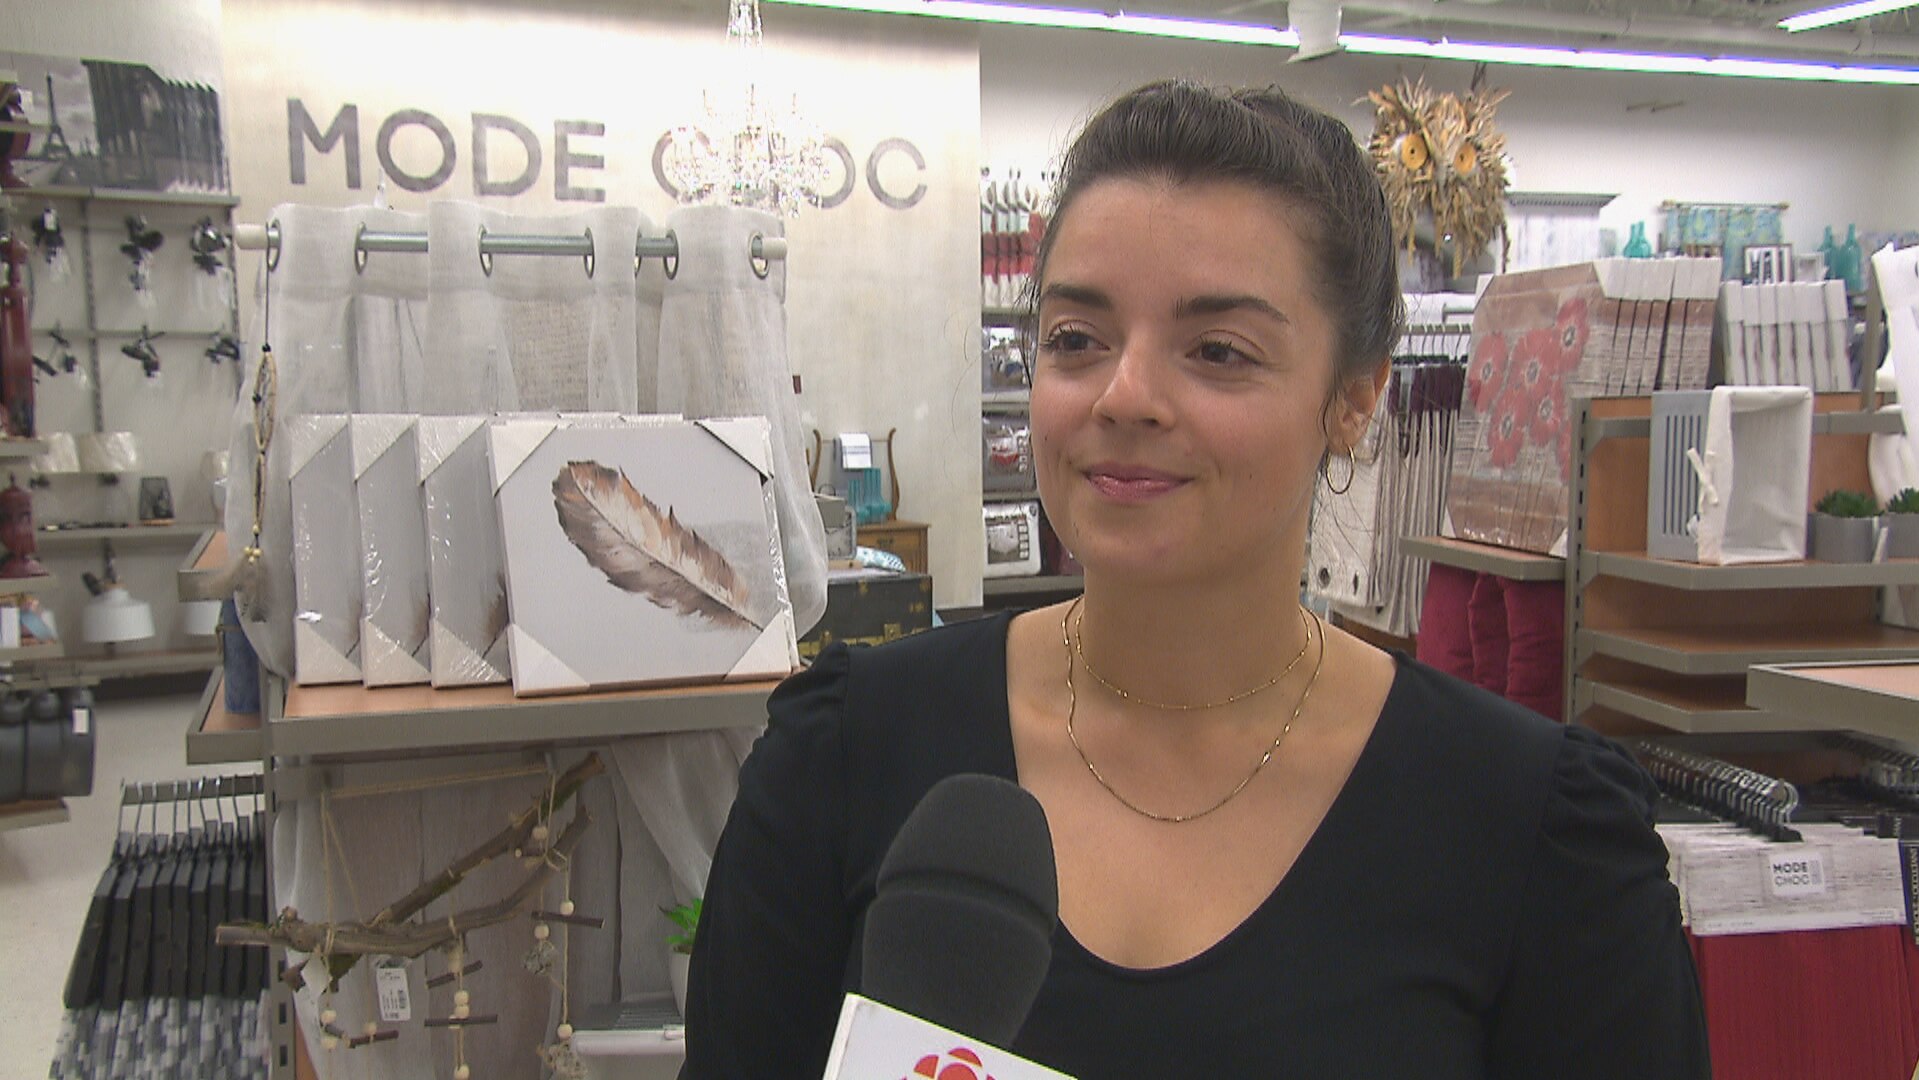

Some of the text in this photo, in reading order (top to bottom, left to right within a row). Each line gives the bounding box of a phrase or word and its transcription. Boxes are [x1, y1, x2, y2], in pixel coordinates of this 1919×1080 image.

[287, 97, 928, 211] MODE COC
[1773, 861, 1808, 874] MODE
